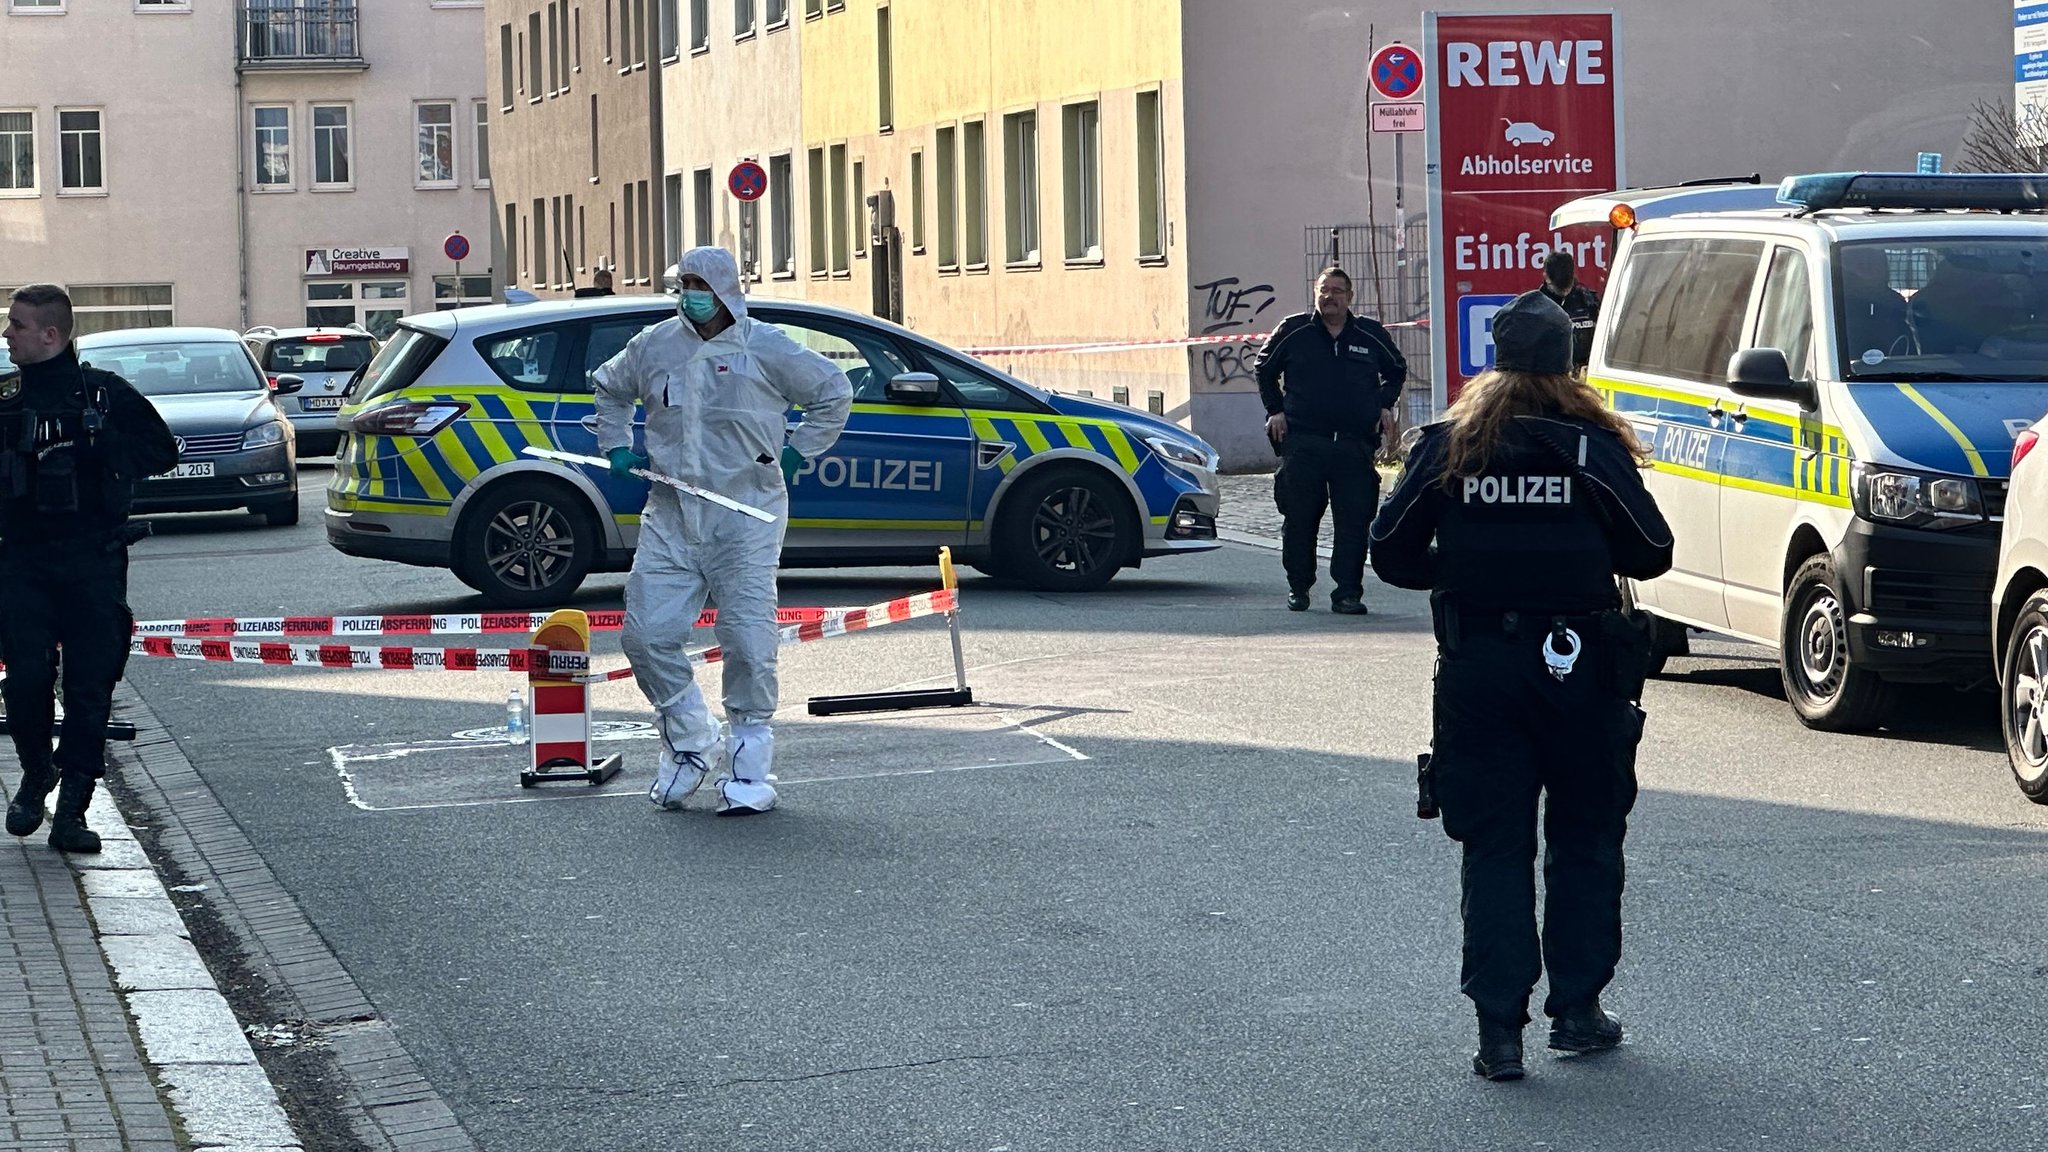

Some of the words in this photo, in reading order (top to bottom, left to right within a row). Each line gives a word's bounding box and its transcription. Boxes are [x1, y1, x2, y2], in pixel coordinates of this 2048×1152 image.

[1447, 40, 1605, 87] REWE
[1393, 119, 1406, 128] frei
[1460, 153, 1593, 175] Abholservice
[332, 248, 380, 260] Creative
[333, 261, 401, 272] Raumgestaltung
[1662, 427, 1712, 470] POLIZEI
[189, 463, 211, 476] 203
[792, 456, 942, 491] POLIZEI
[1463, 475, 1571, 504] POLIZEI
[224, 620, 329, 632] POLIZEIABSPERRUNG
[342, 618, 447, 631] POLIZEIABSPERRUNG
[461, 615, 549, 630] POLIZEIABSPERR
[378, 651, 447, 667] POLIZEIABSPERRUNG
[455, 653, 525, 668] POLIZEIABSPERRUNG
